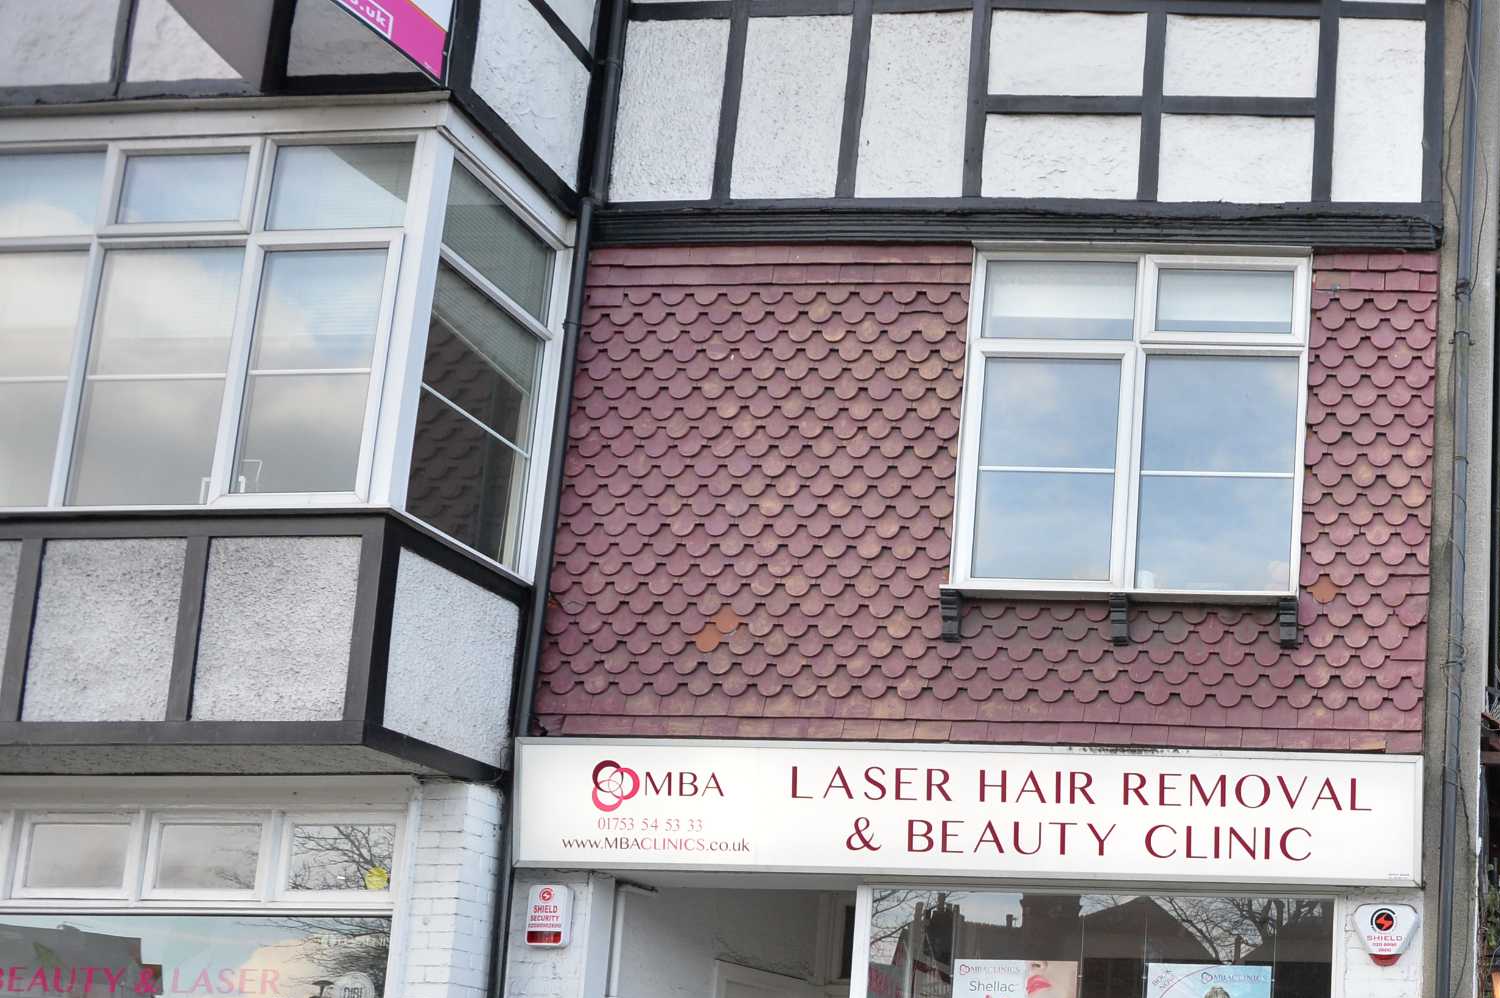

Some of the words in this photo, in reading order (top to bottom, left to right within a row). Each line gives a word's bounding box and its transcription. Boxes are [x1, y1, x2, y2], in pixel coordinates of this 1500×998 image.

[645, 771, 725, 797] MBA
[791, 765, 952, 802] LASER
[979, 769, 1096, 805] HAIR
[1122, 772, 1373, 812] REMOVAL
[598, 817, 634, 831] 01753
[641, 818, 659, 832] 54
[665, 818, 681, 832] 53
[687, 819, 703, 832] 33
[562, 836, 750, 852] www.MBACLINICS.co.uk
[845, 816, 883, 852] &
[907, 818, 1117, 857] BEAUTY
[1144, 824, 1313, 862] CLINIC
[533, 905, 558, 913] SHIELD
[134, 965, 163, 993] &
[171, 967, 281, 995] LASER
[969, 980, 1015, 992] Shellac
